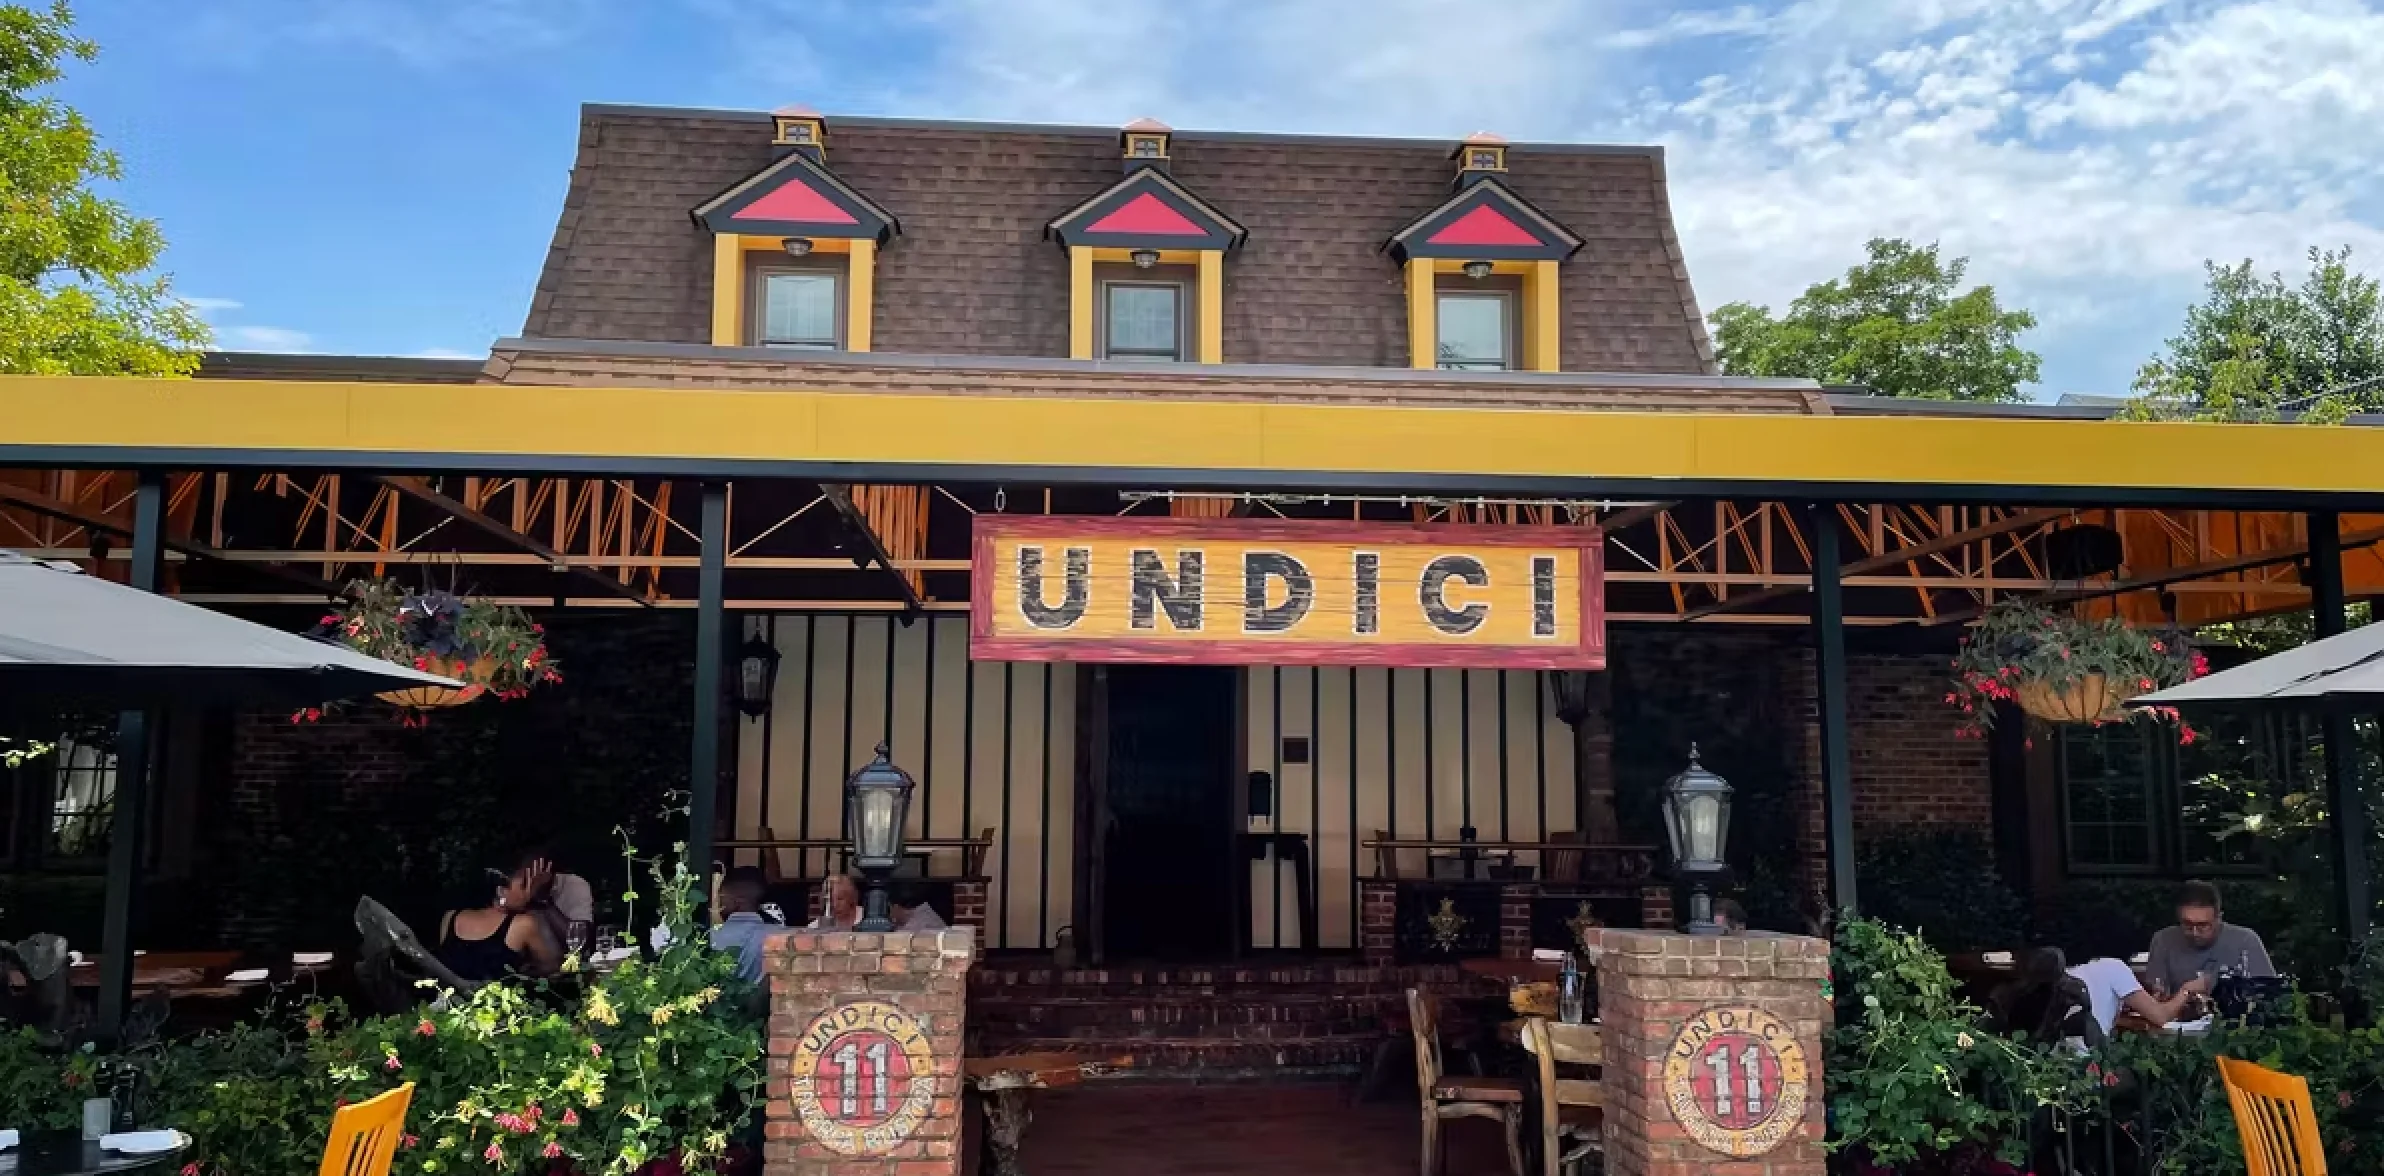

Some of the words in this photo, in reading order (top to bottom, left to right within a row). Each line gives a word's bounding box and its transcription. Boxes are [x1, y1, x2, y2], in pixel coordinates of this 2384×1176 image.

[1017, 545, 1558, 637] UNDICI
[803, 1006, 919, 1052] UNDICI
[1676, 1011, 1793, 1059] UNDICI
[832, 1042, 889, 1119] 11
[1704, 1043, 1763, 1117] 11
